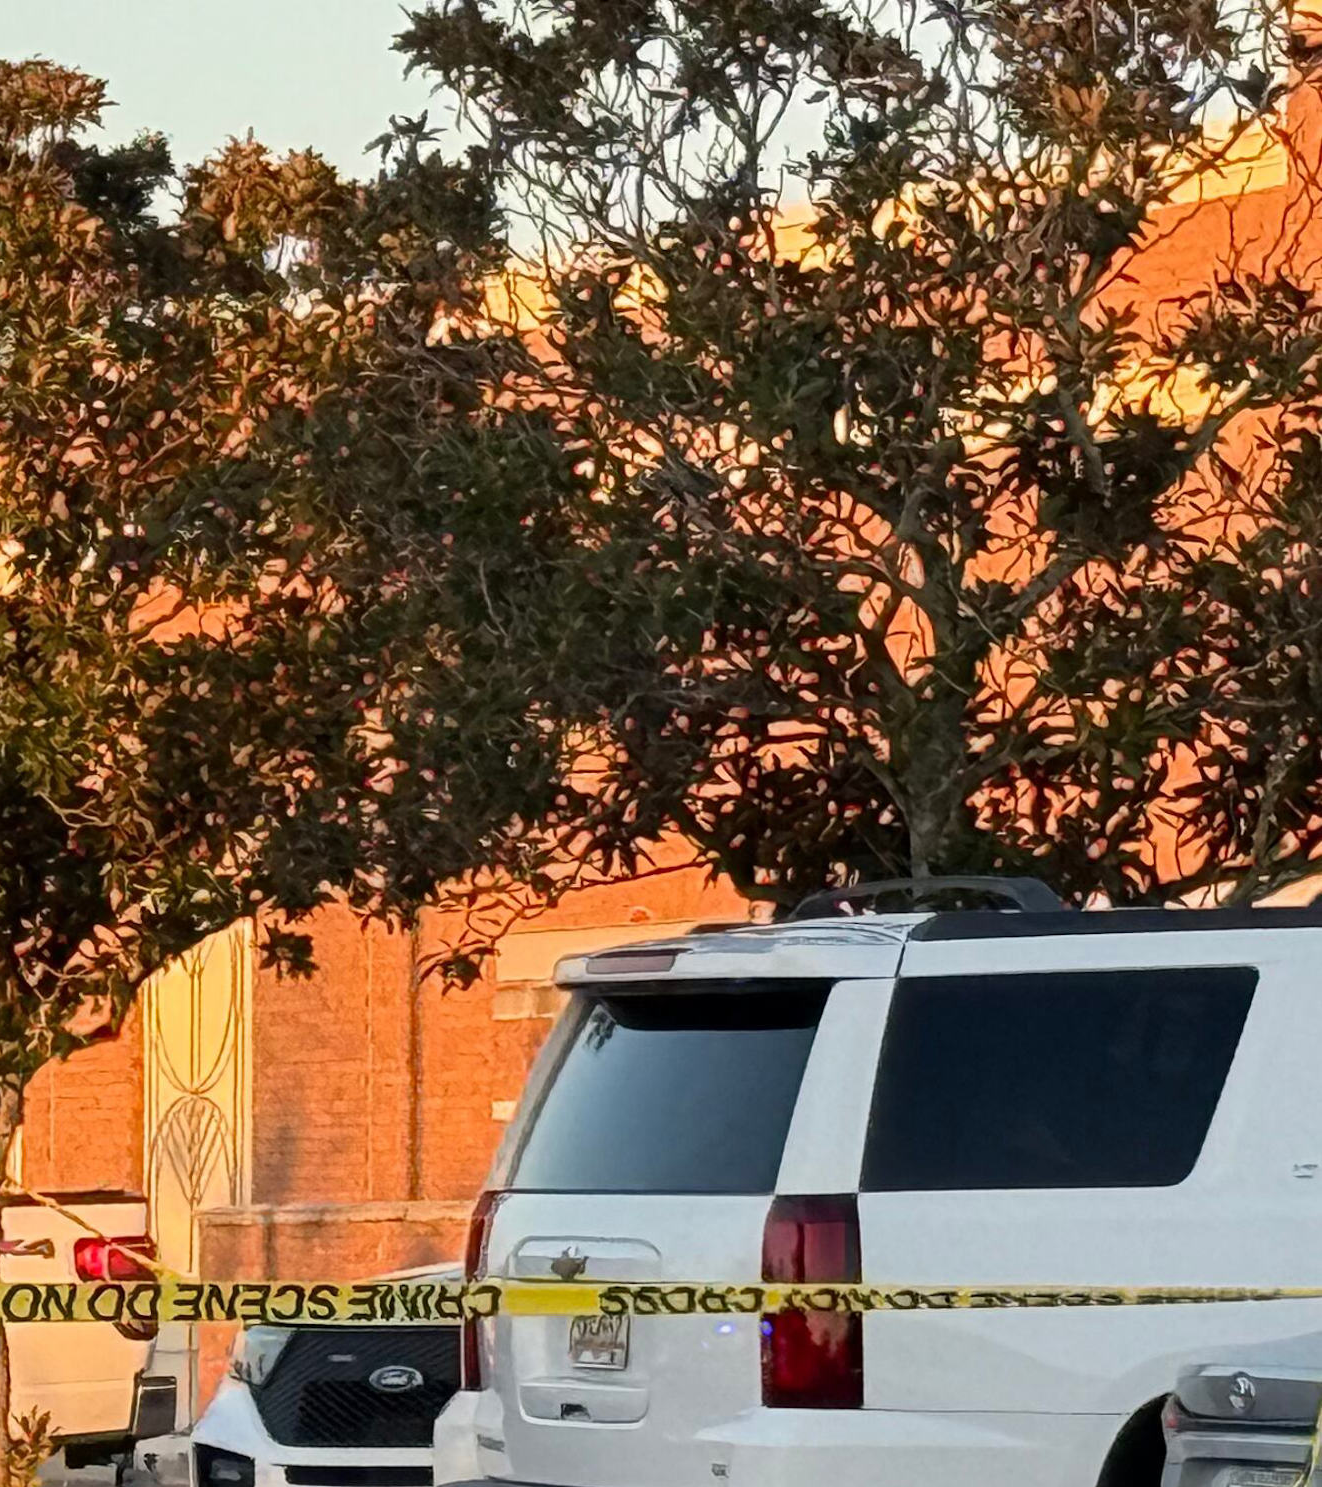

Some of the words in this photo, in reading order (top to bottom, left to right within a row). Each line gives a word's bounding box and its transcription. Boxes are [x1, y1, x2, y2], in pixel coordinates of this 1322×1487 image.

[87, 1283, 158, 1322] DO
[171, 1283, 339, 1321] SCENE
[348, 1284, 501, 1321] CRIME
[598, 1285, 764, 1315] CROSS
